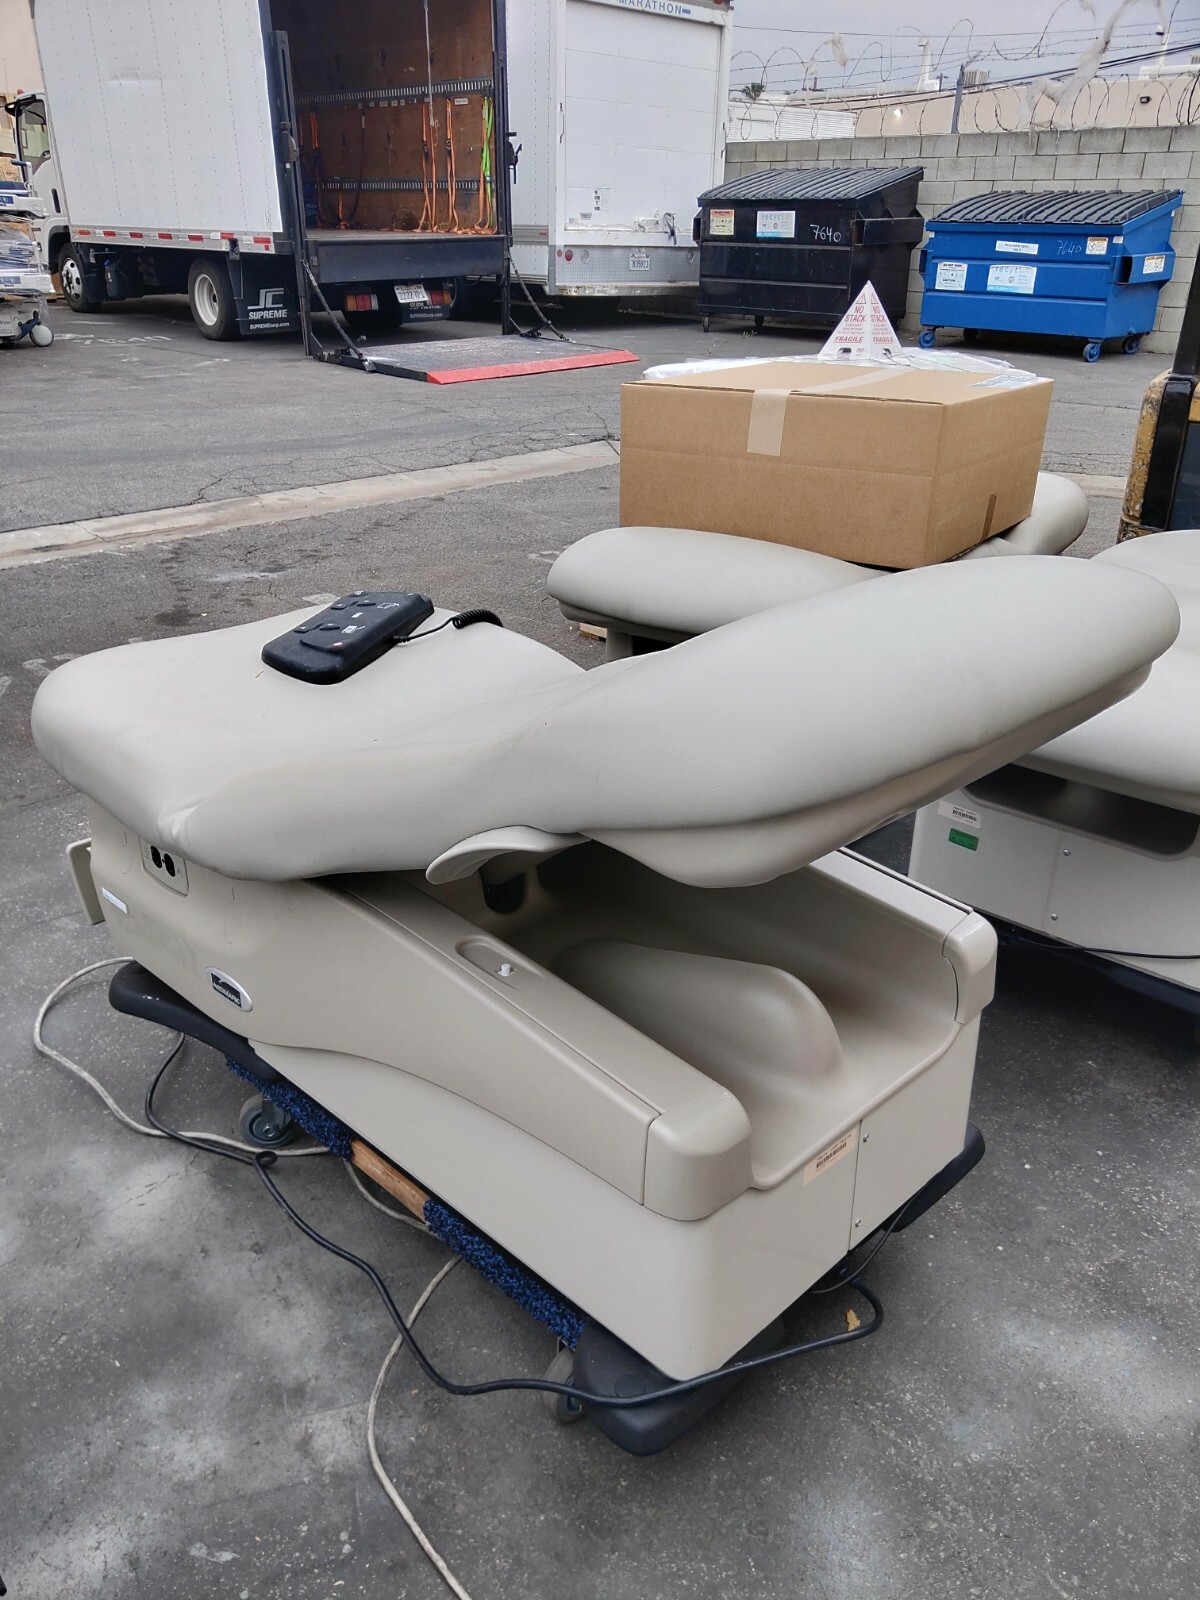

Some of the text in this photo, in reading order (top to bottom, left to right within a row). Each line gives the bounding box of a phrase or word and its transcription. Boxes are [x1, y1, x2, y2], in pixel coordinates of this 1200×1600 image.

[810, 224, 842, 242] 7640
[248, 309, 288, 320] SUPREME
[872, 306, 880, 314] NO
